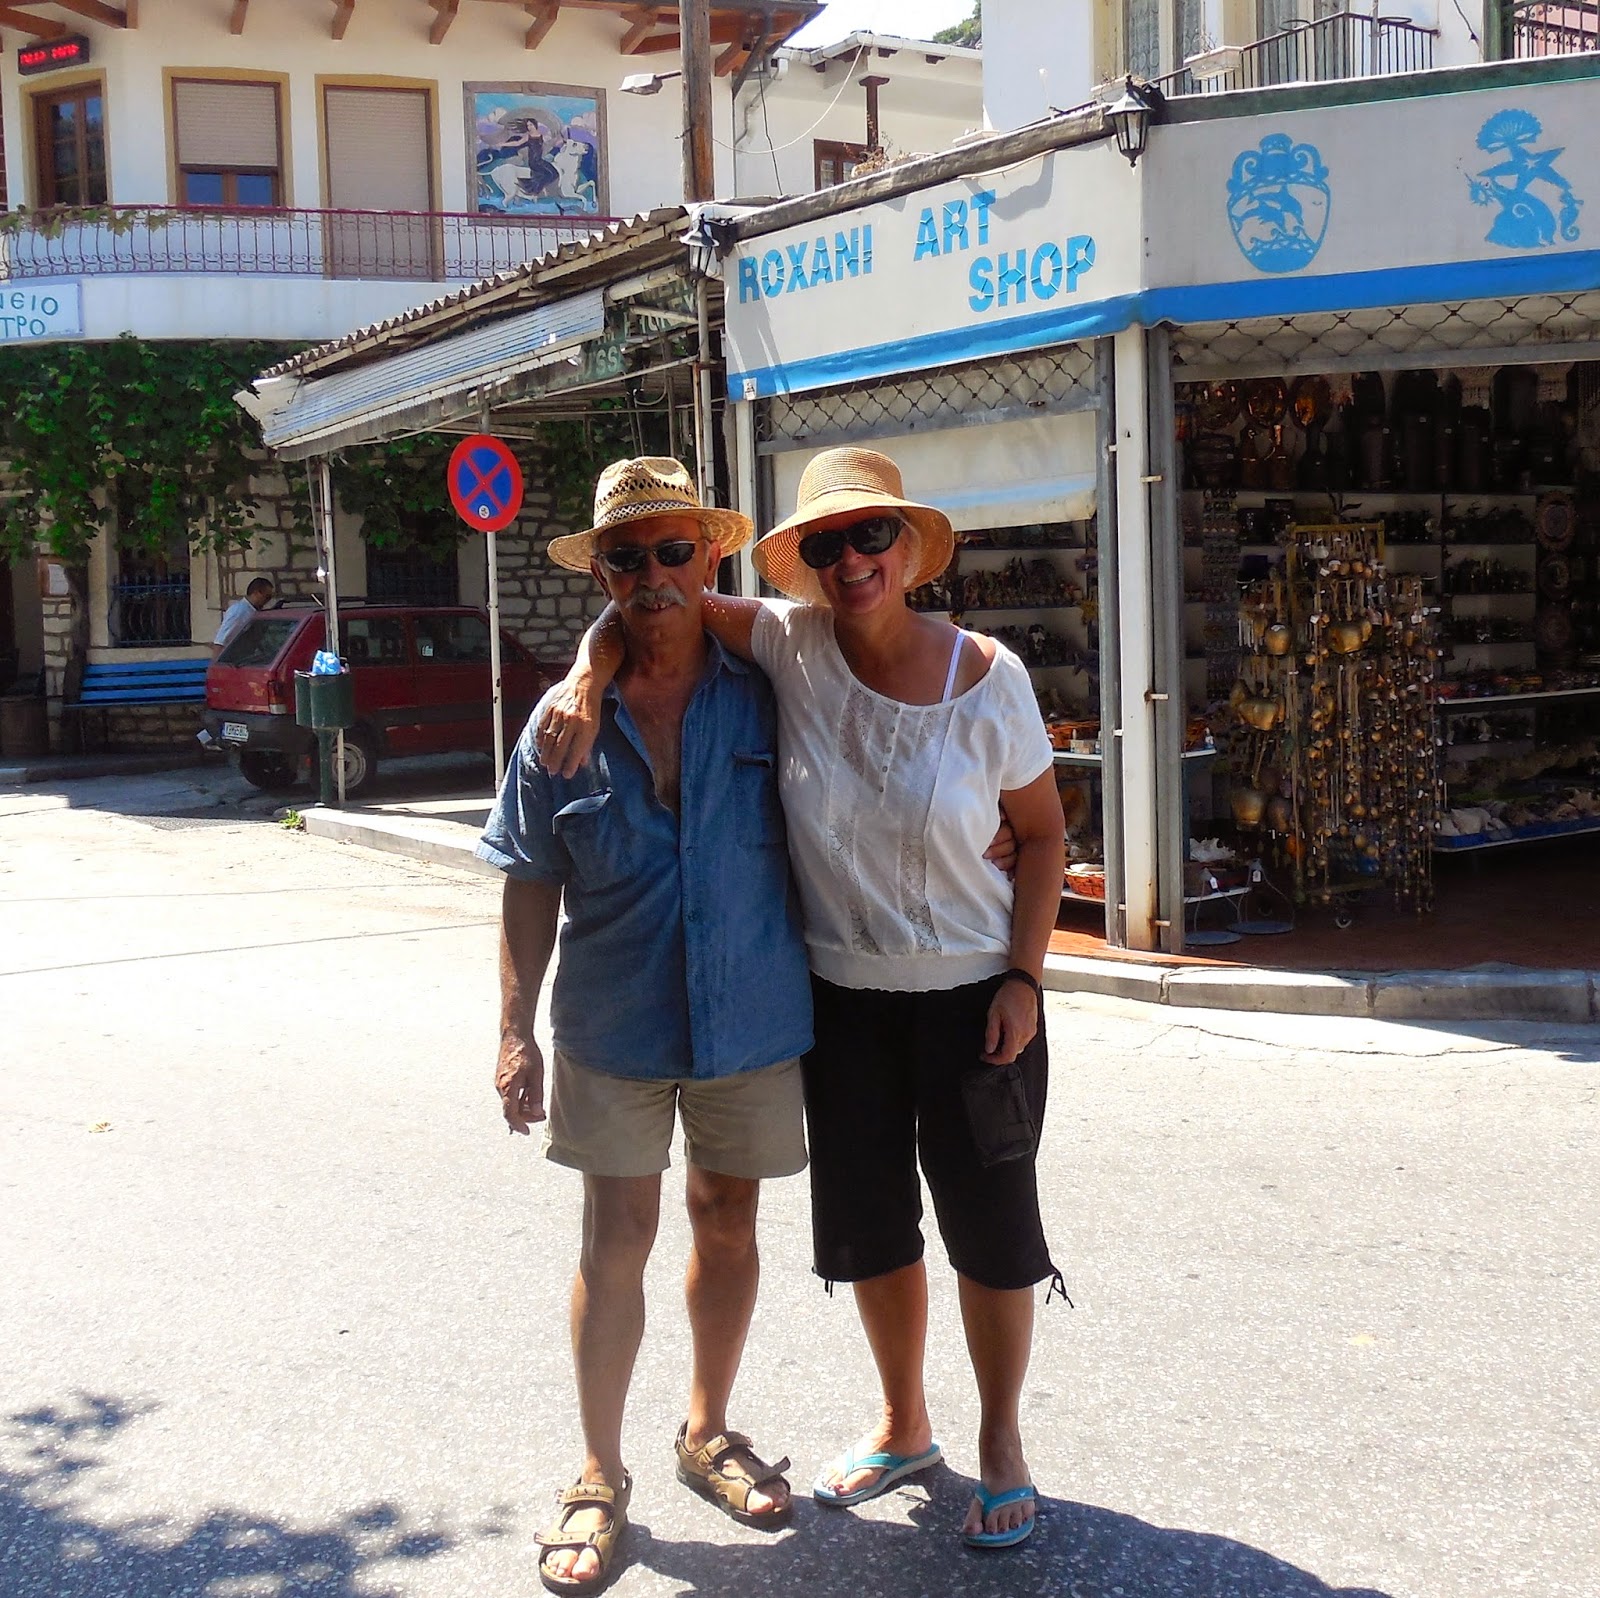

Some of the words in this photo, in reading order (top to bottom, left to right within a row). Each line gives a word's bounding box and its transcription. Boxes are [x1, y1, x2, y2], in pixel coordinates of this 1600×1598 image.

[738, 224, 874, 305] ROXANI
[913, 189, 997, 262] ART
[967, 234, 1096, 313] SHOP
